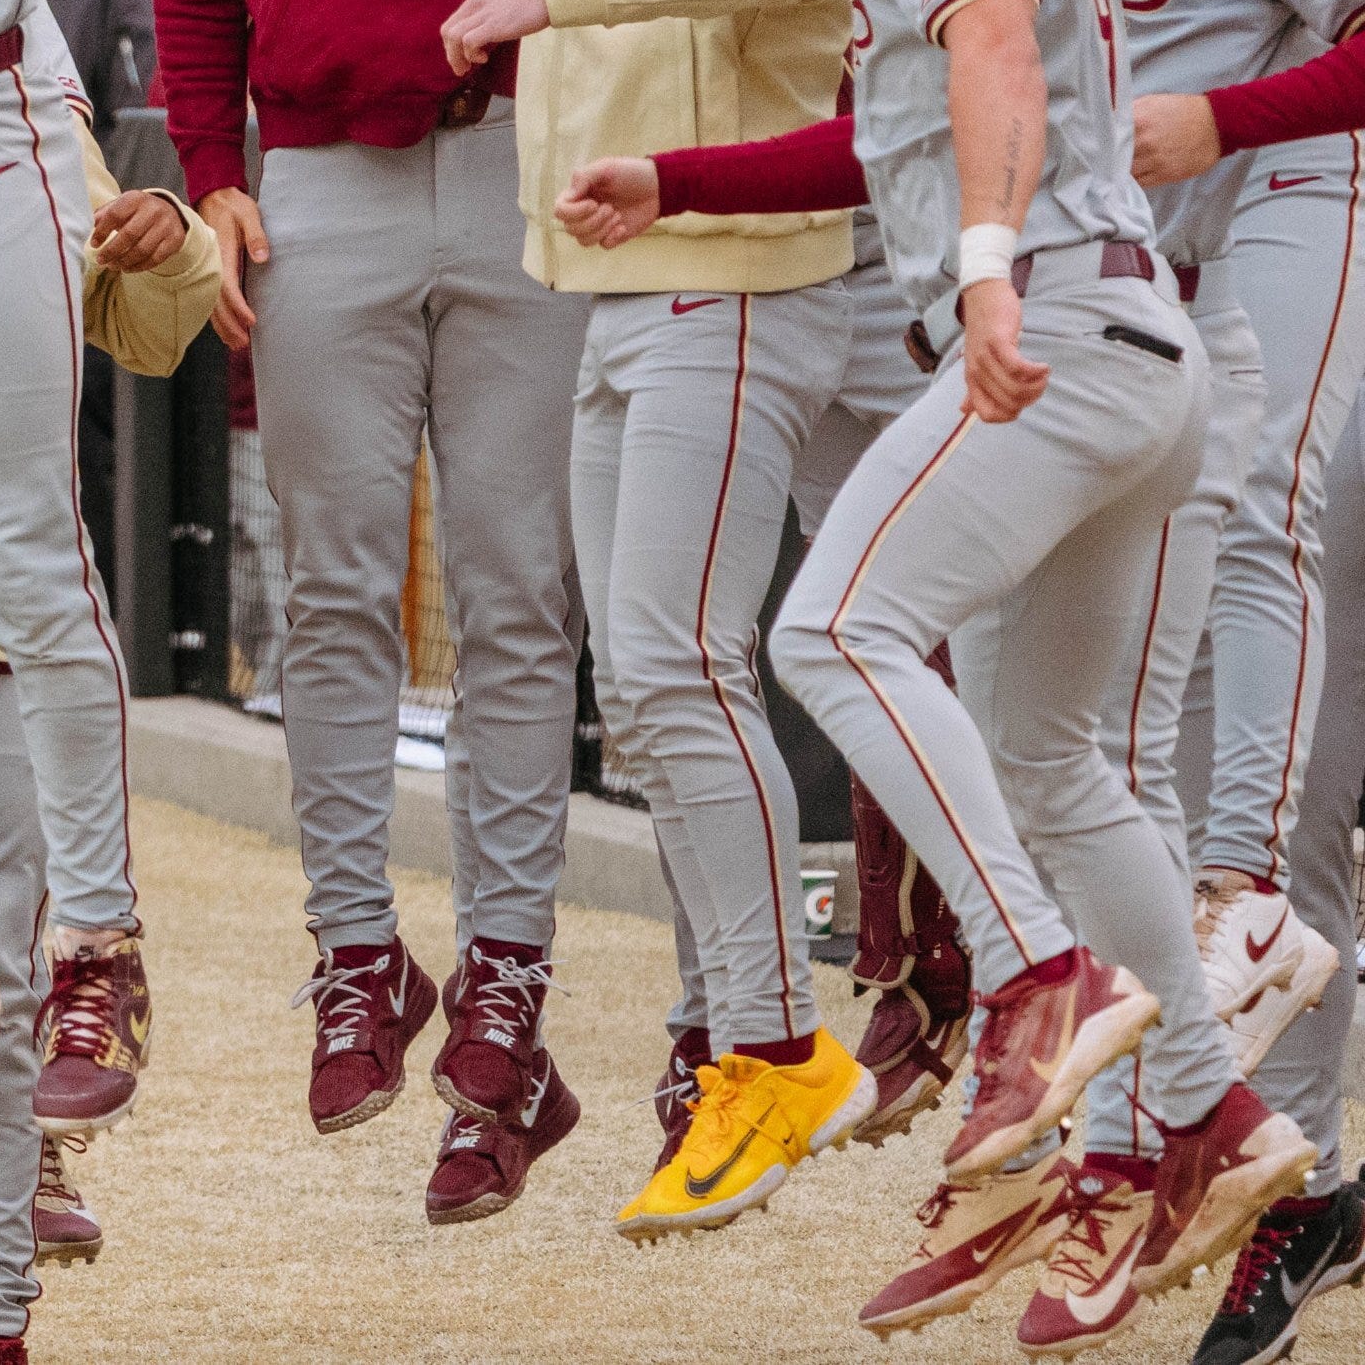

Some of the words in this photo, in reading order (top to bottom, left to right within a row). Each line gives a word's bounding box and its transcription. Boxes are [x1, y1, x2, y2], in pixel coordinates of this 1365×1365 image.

[327, 1034, 357, 1055] NIKE
[484, 1027, 517, 1049] NIKE
[449, 1135, 481, 1150] NIKE
